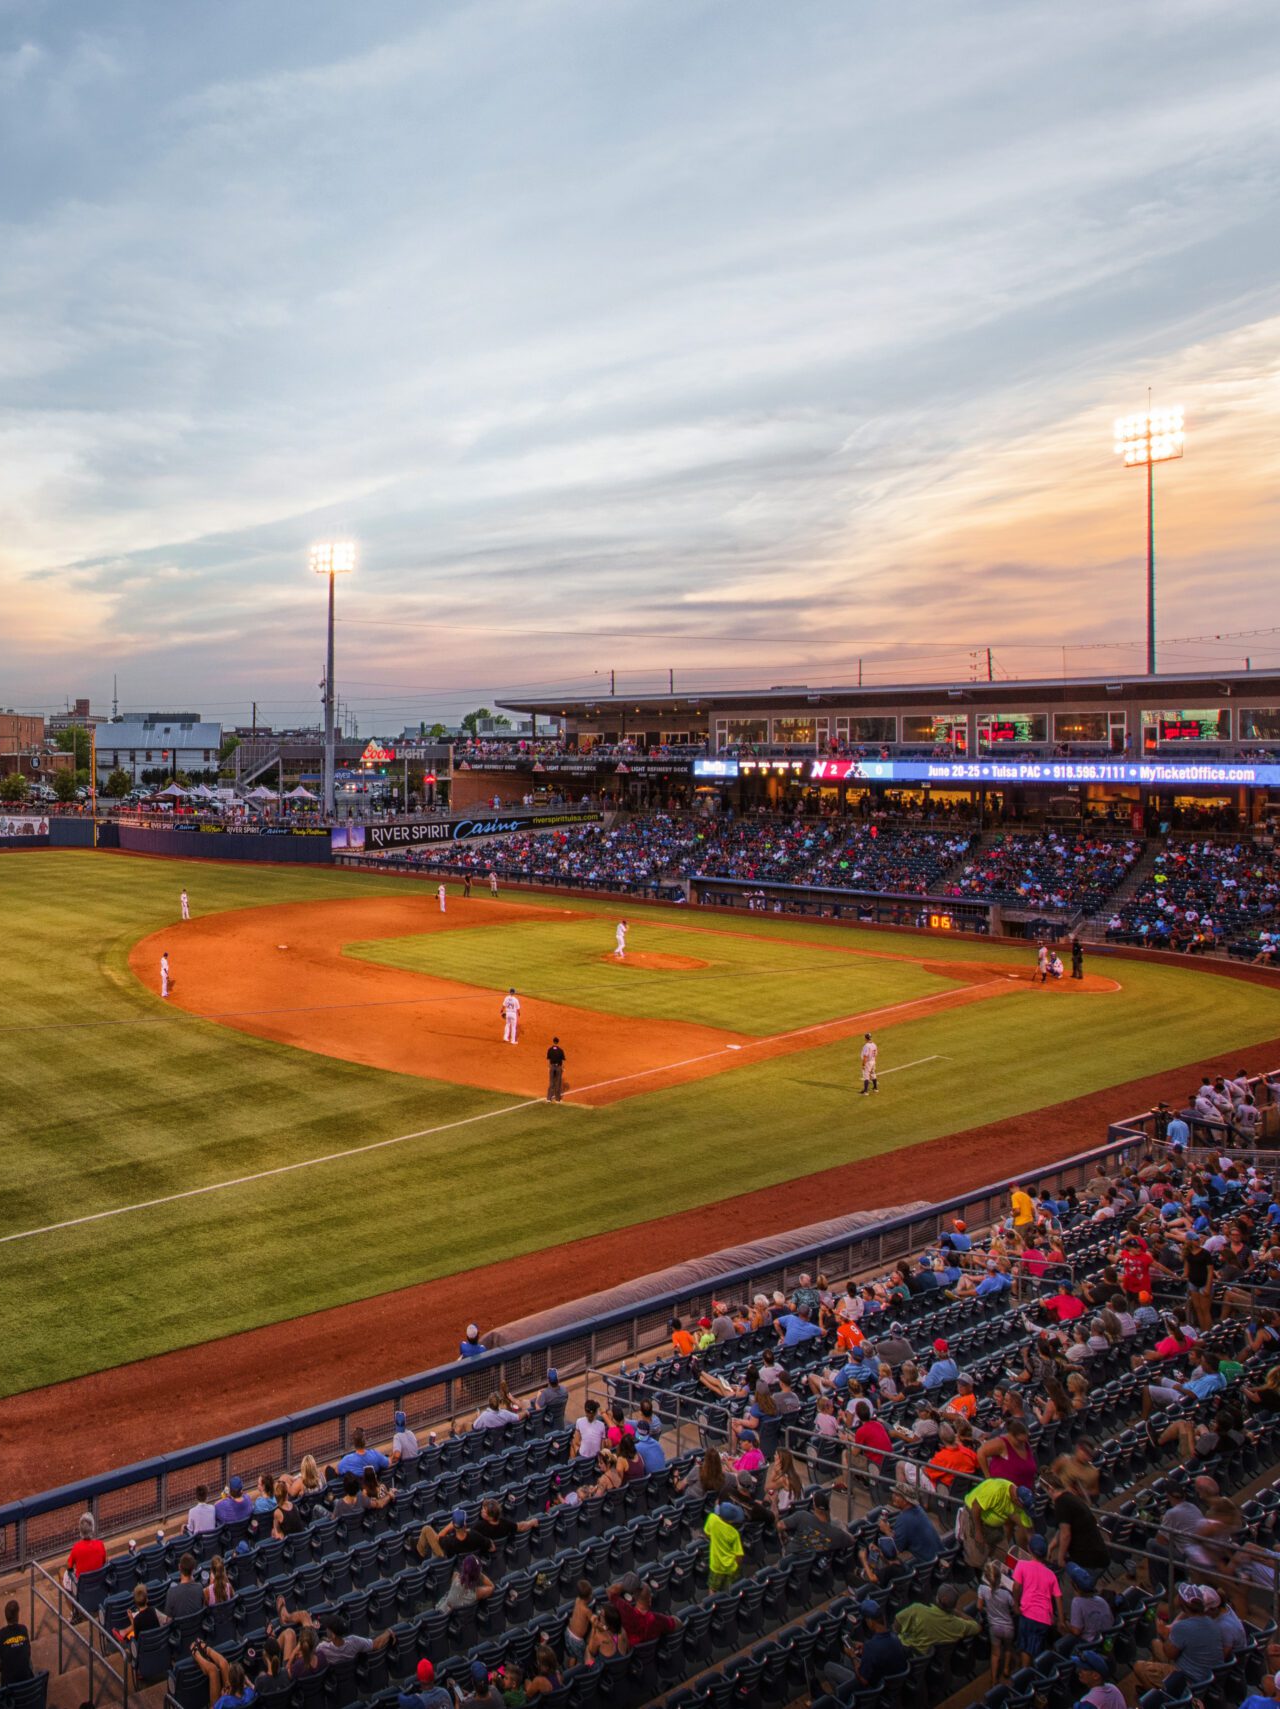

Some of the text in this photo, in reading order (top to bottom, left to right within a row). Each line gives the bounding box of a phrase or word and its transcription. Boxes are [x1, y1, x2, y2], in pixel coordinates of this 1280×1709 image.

[362, 745, 426, 759] Coors LIGHT
[830, 764, 838, 775] 2
[928, 765, 1255, 781] June 20-25 Tulsa PAC 918.596.7111 MyTicketOffice.com
[226, 826, 243, 835] RIVER
[243, 826, 260, 834] SPIRIT
[371, 813, 599, 846] RIVER SPIRIT Casino riverspirittulsa.com
